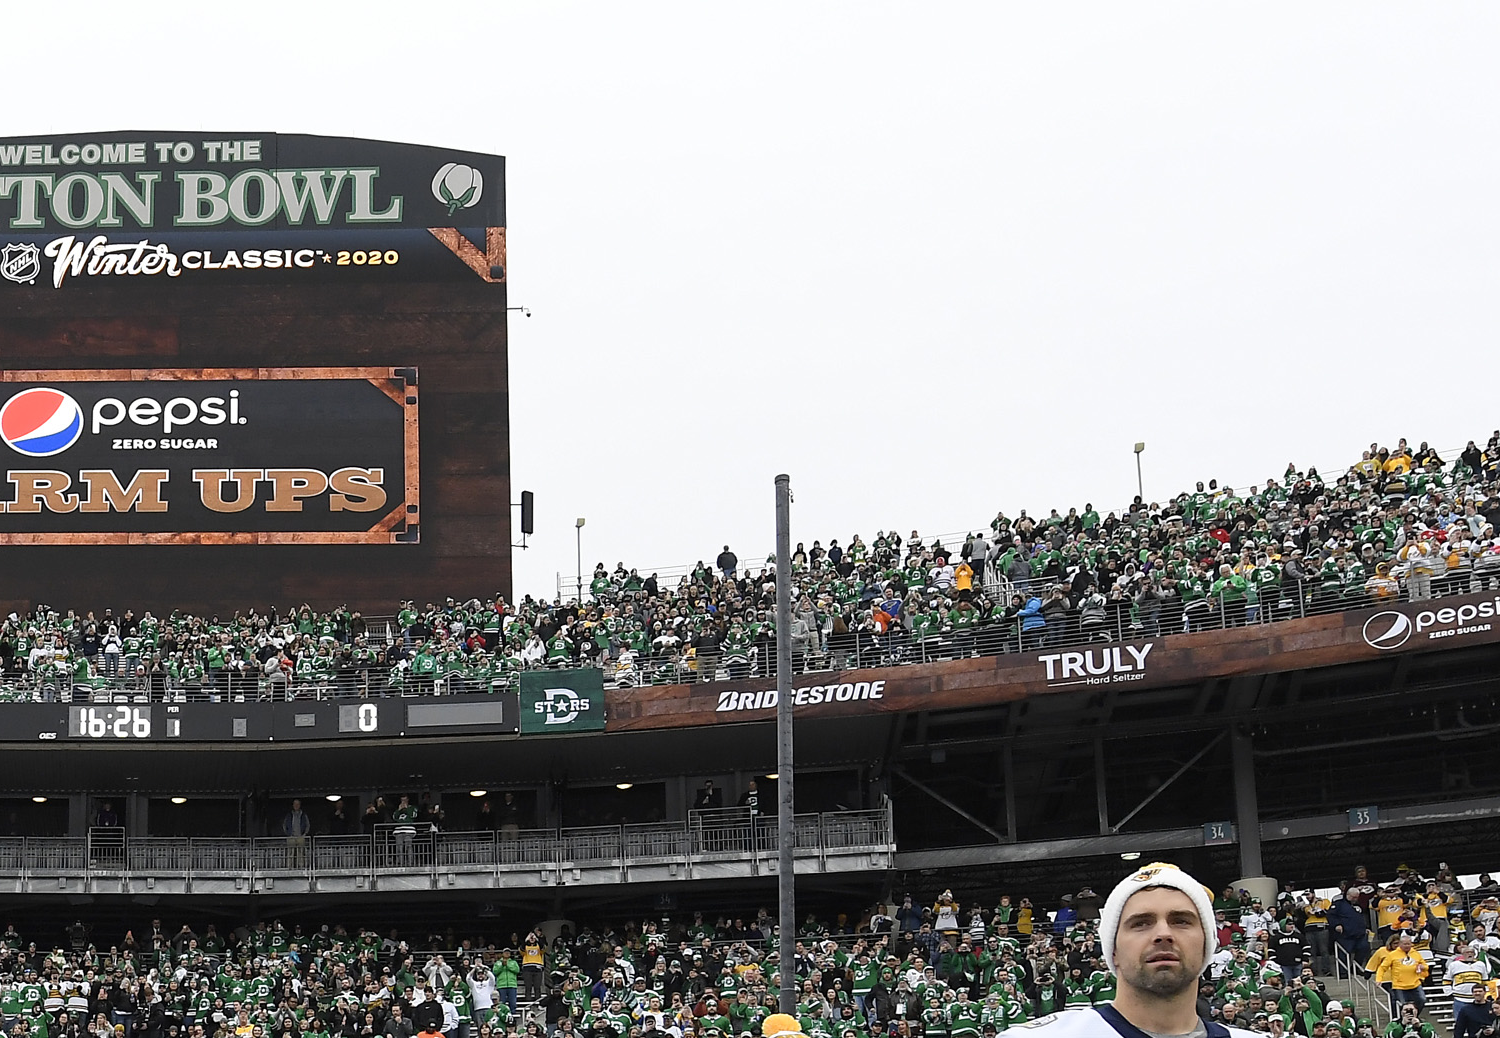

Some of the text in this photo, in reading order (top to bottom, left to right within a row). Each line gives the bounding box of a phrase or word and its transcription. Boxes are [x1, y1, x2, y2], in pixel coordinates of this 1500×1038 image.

[156, 142, 194, 163] TO
[204, 140, 261, 162] THE
[175, 167, 403, 229] BOWL
[9, 252, 37, 275] NHL
[45, 235, 400, 289] Winter CLASSIC 2020
[92, 390, 246, 434] pepsi
[112, 438, 218, 449] ZERO SUGAR
[194, 467, 387, 513] UPS
[1429, 624, 1492, 639] ZERO SUGAR
[1038, 643, 1154, 680] TRULY
[1086, 672, 1146, 685] Hard Seltzer
[79, 705, 151, 738] 16:26
[358, 703, 378, 732] 0
[1356, 811, 1371, 826] 35
[1210, 825, 1225, 840] 34
